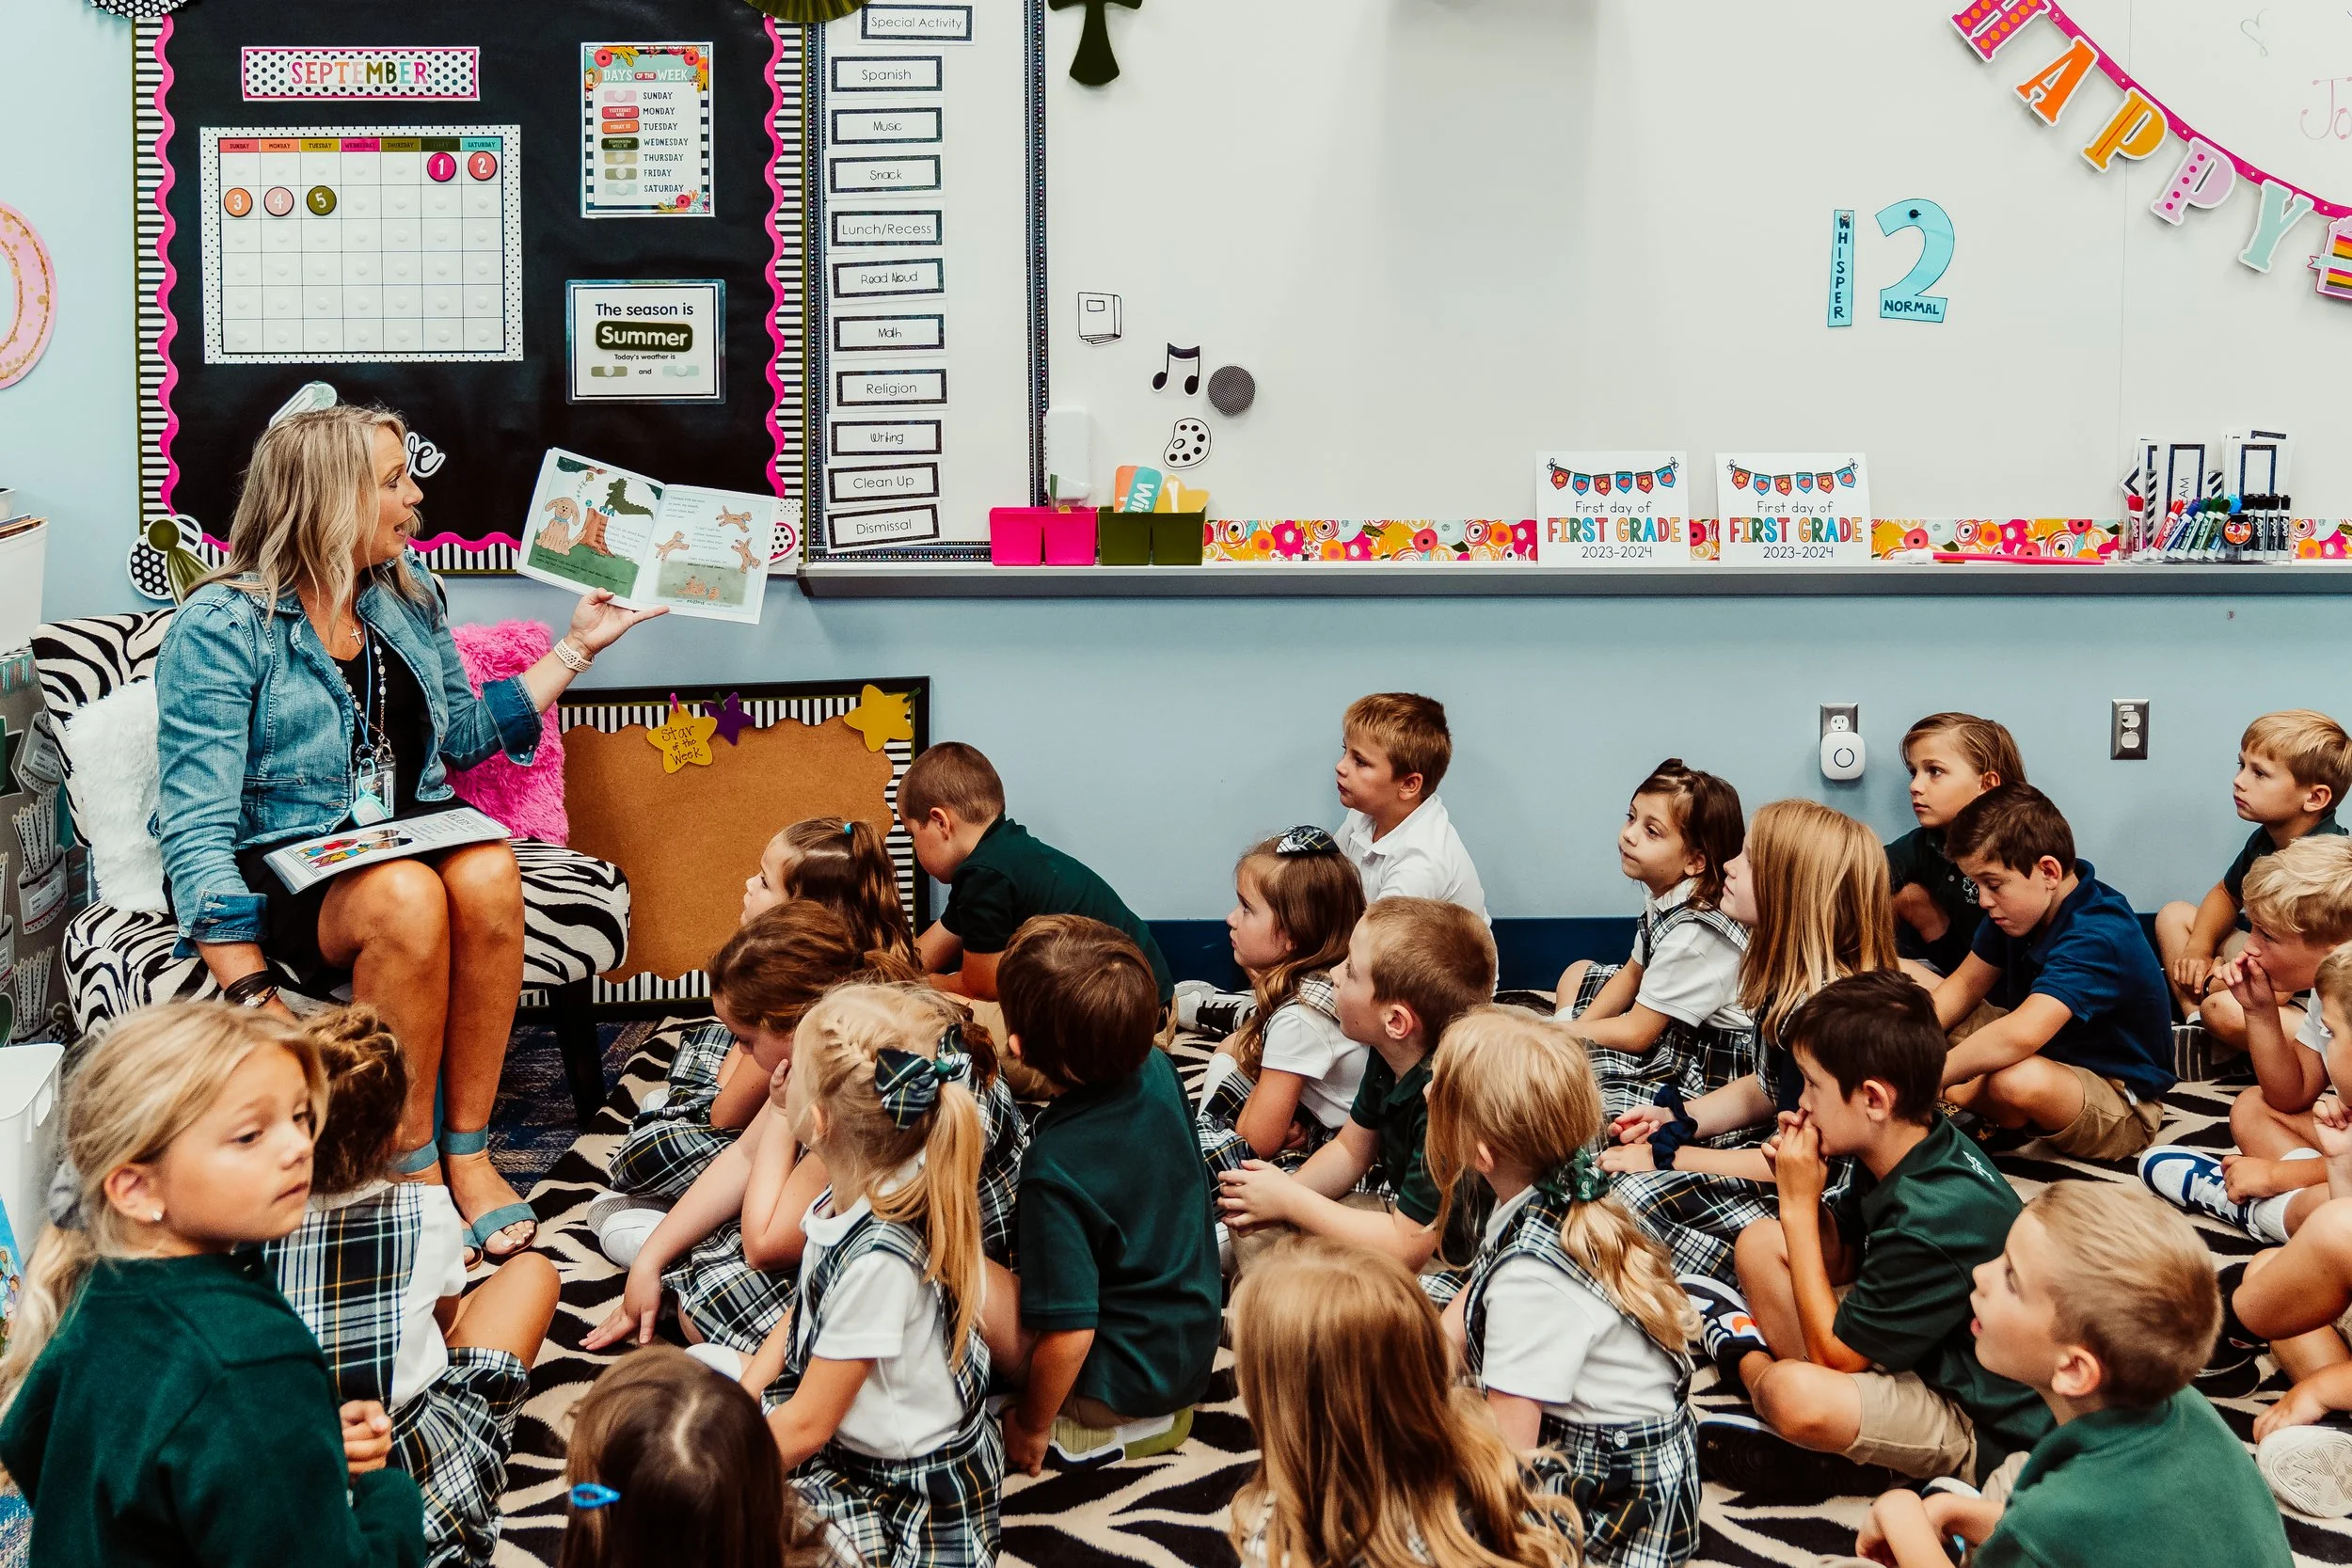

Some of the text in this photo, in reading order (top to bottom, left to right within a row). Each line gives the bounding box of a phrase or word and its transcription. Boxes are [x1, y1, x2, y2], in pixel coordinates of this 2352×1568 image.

[871, 16, 962, 30] Special Activity
[291, 60, 429, 86] SEPTEMBER
[602, 69, 633, 82] DAYS
[657, 69, 688, 81] WEEK
[862, 69, 912, 82] Spanish
[643, 91, 673, 100] SUNDAY
[643, 107, 675, 116] MONDAY
[644, 122, 678, 131] TUESDAY
[873, 120, 902, 132] Music
[644, 137, 689, 147] WEDNESDAY
[1950, 0, 2314, 273] HAPPY
[644, 153, 684, 162] THURSDAY
[437, 157, 487, 175] 1 2
[869, 169, 902, 181] Snack
[644, 184, 685, 193] SATURDAY
[233, 192, 327, 211] 3 4 5
[842, 223, 931, 235] Lunch/Recess
[1834, 217, 1850, 319] WHISPER
[861, 271, 918, 284] Read Aloud
[595, 302, 694, 316] The season is
[1883, 299, 1940, 315] NORMAL
[601, 325, 689, 346] Summer
[878, 326, 902, 339] Math
[866, 383, 917, 396] Religion
[870, 432, 904, 445] Writing
[852, 476, 914, 489] Clean Up
[1575, 500, 1652, 516] First day of
[1756, 500, 1835, 516] First day of
[856, 519, 912, 535] Dismissal
[1548, 517, 1681, 543] FIRST GRADE
[1729, 517, 1864, 543] FIRST GRADE
[1581, 546, 1652, 559] 2023-2024
[1762, 546, 1835, 559] 2023-2024
[661, 725, 694, 741] Star
[673, 738, 696, 751] of the
[670, 747, 703, 765] Week
